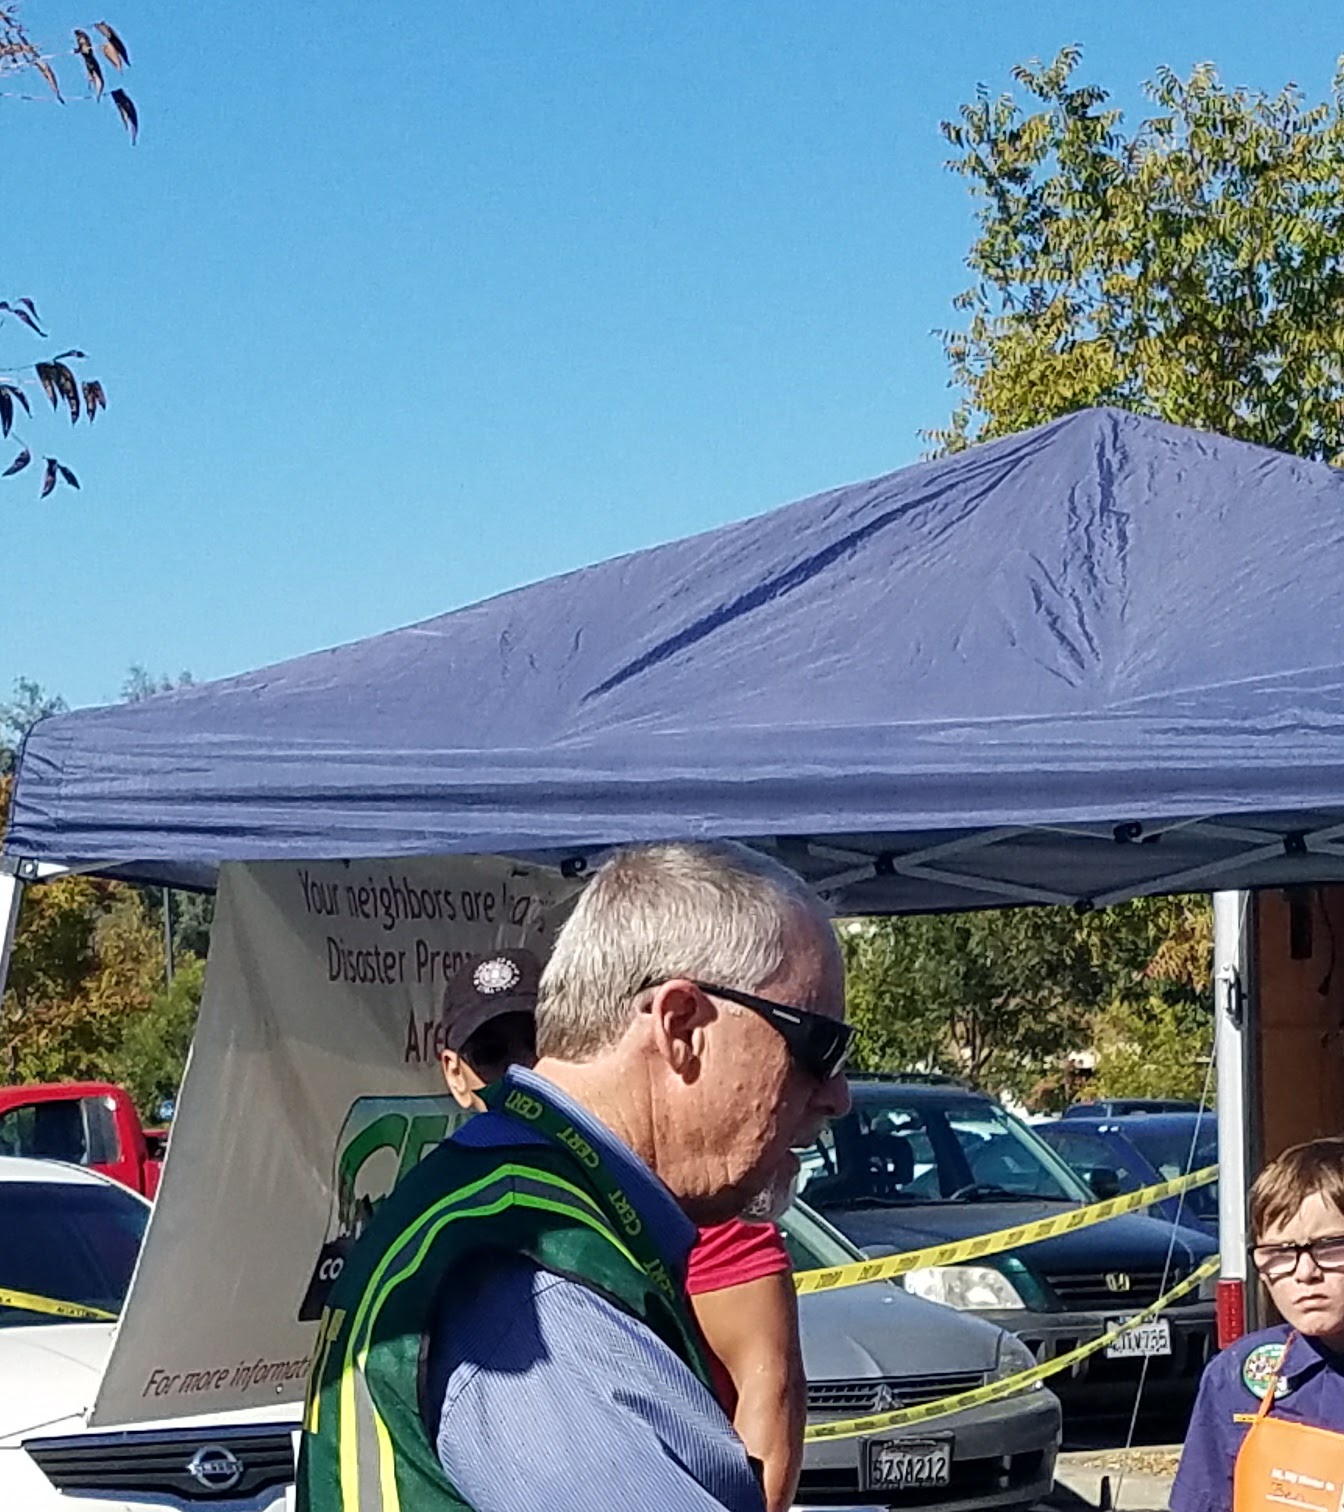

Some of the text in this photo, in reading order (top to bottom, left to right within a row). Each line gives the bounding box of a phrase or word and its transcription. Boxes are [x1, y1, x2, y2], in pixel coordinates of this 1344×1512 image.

[298, 868, 340, 916] Your
[346, 876, 456, 931] neighbors
[460, 887, 496, 923] are
[326, 936, 407, 985] Disaster
[505, 1089, 544, 1120] CERT
[556, 1127, 600, 1169] CERT
[607, 1189, 643, 1236] CERT
[142, 1369, 180, 1397] For
[179, 1368, 230, 1393] more
